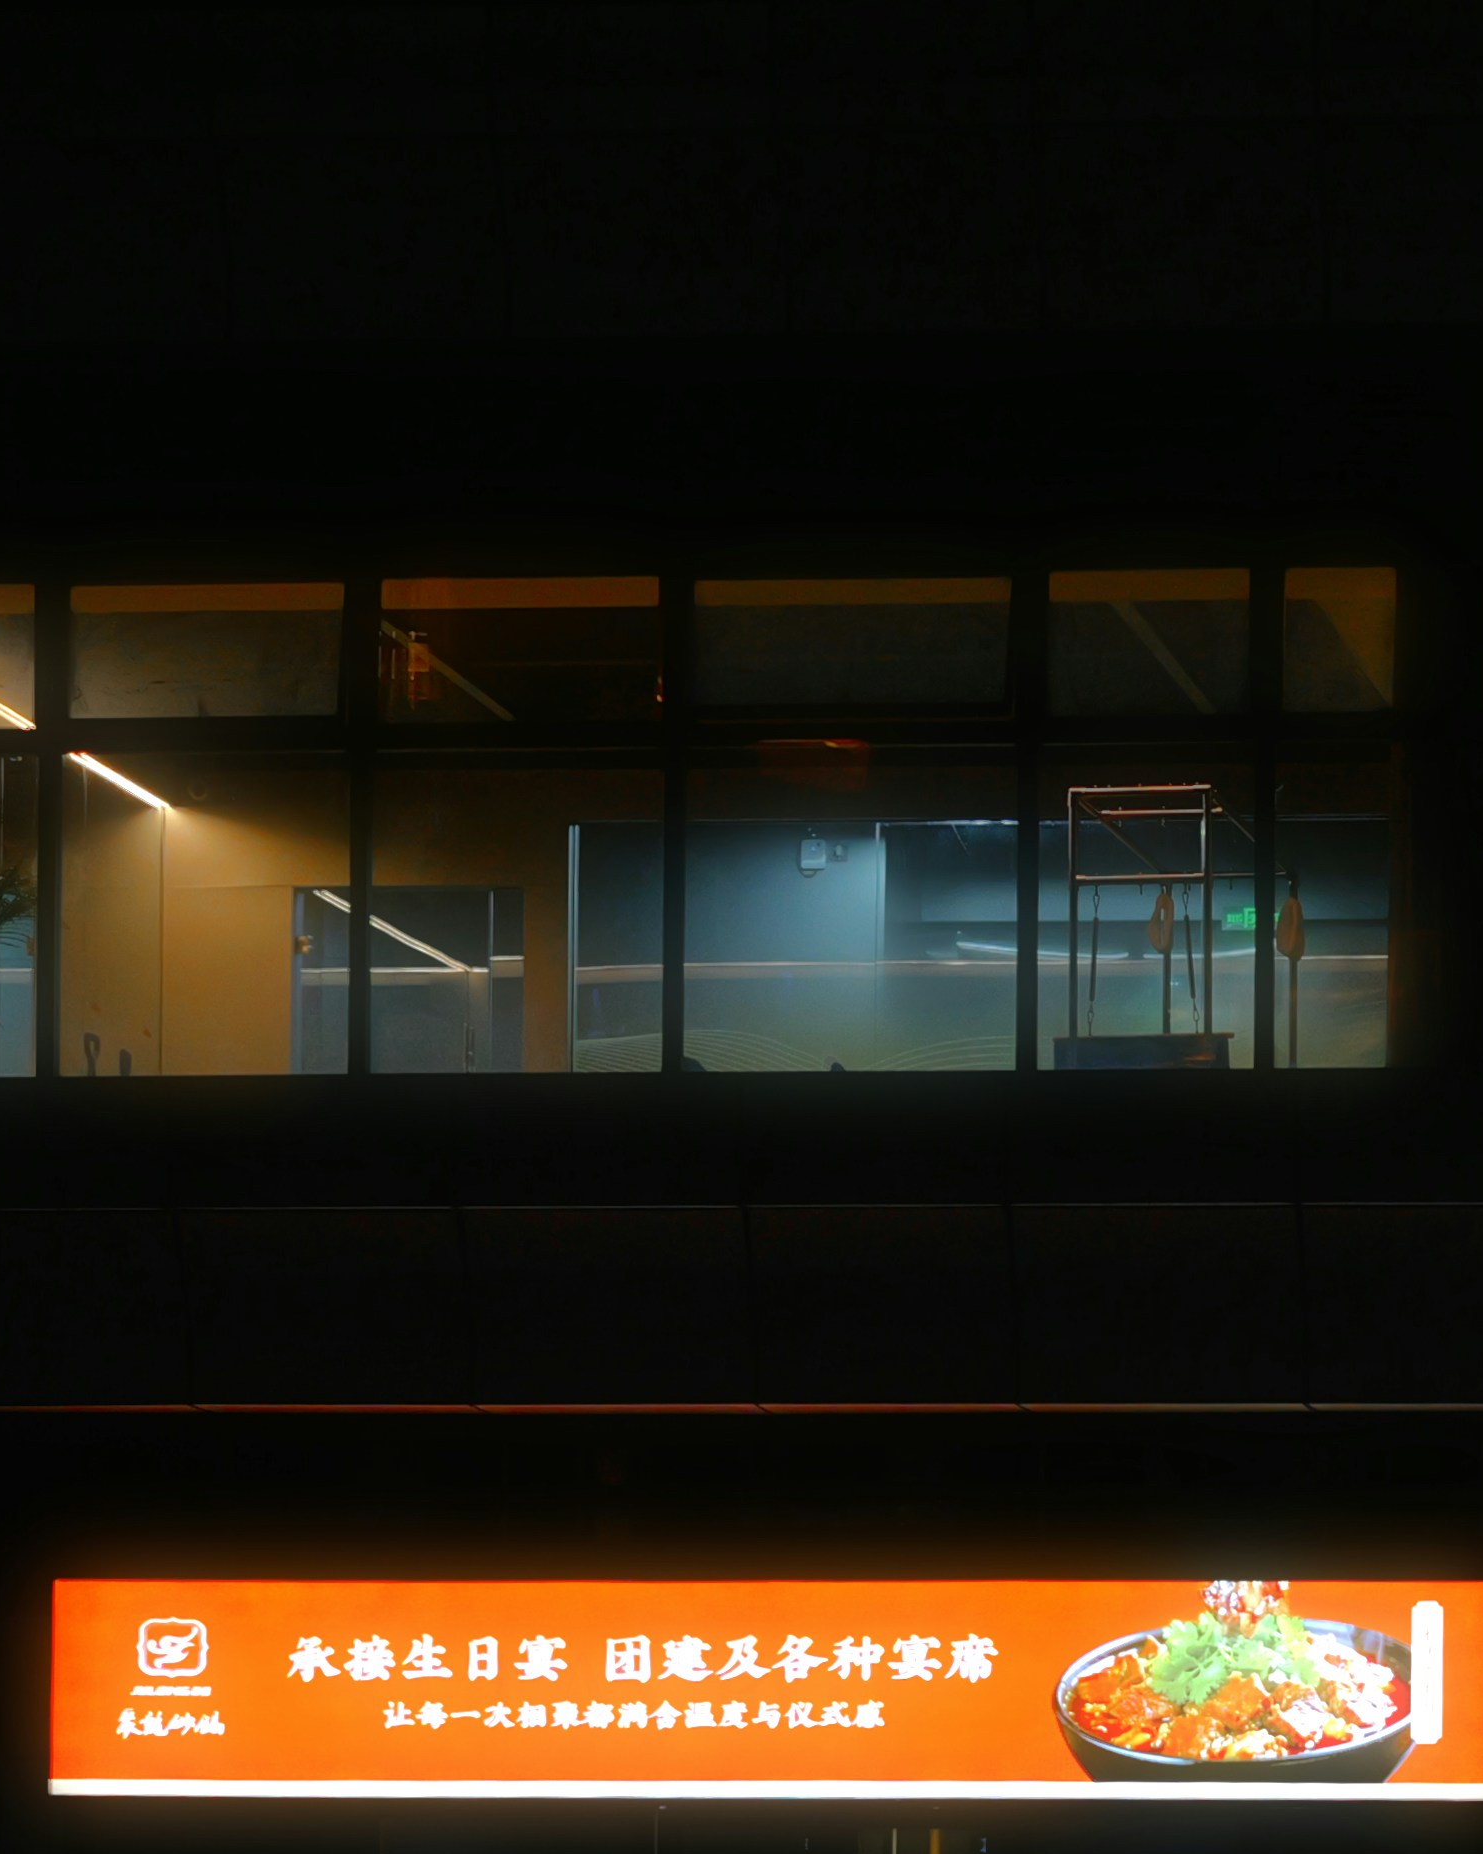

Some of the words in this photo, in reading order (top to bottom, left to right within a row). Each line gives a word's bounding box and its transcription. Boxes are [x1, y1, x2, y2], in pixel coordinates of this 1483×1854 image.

[287, 1633, 568, 1684] 承接生日宴
[604, 1632, 999, 1684] 团建及各种宴席
